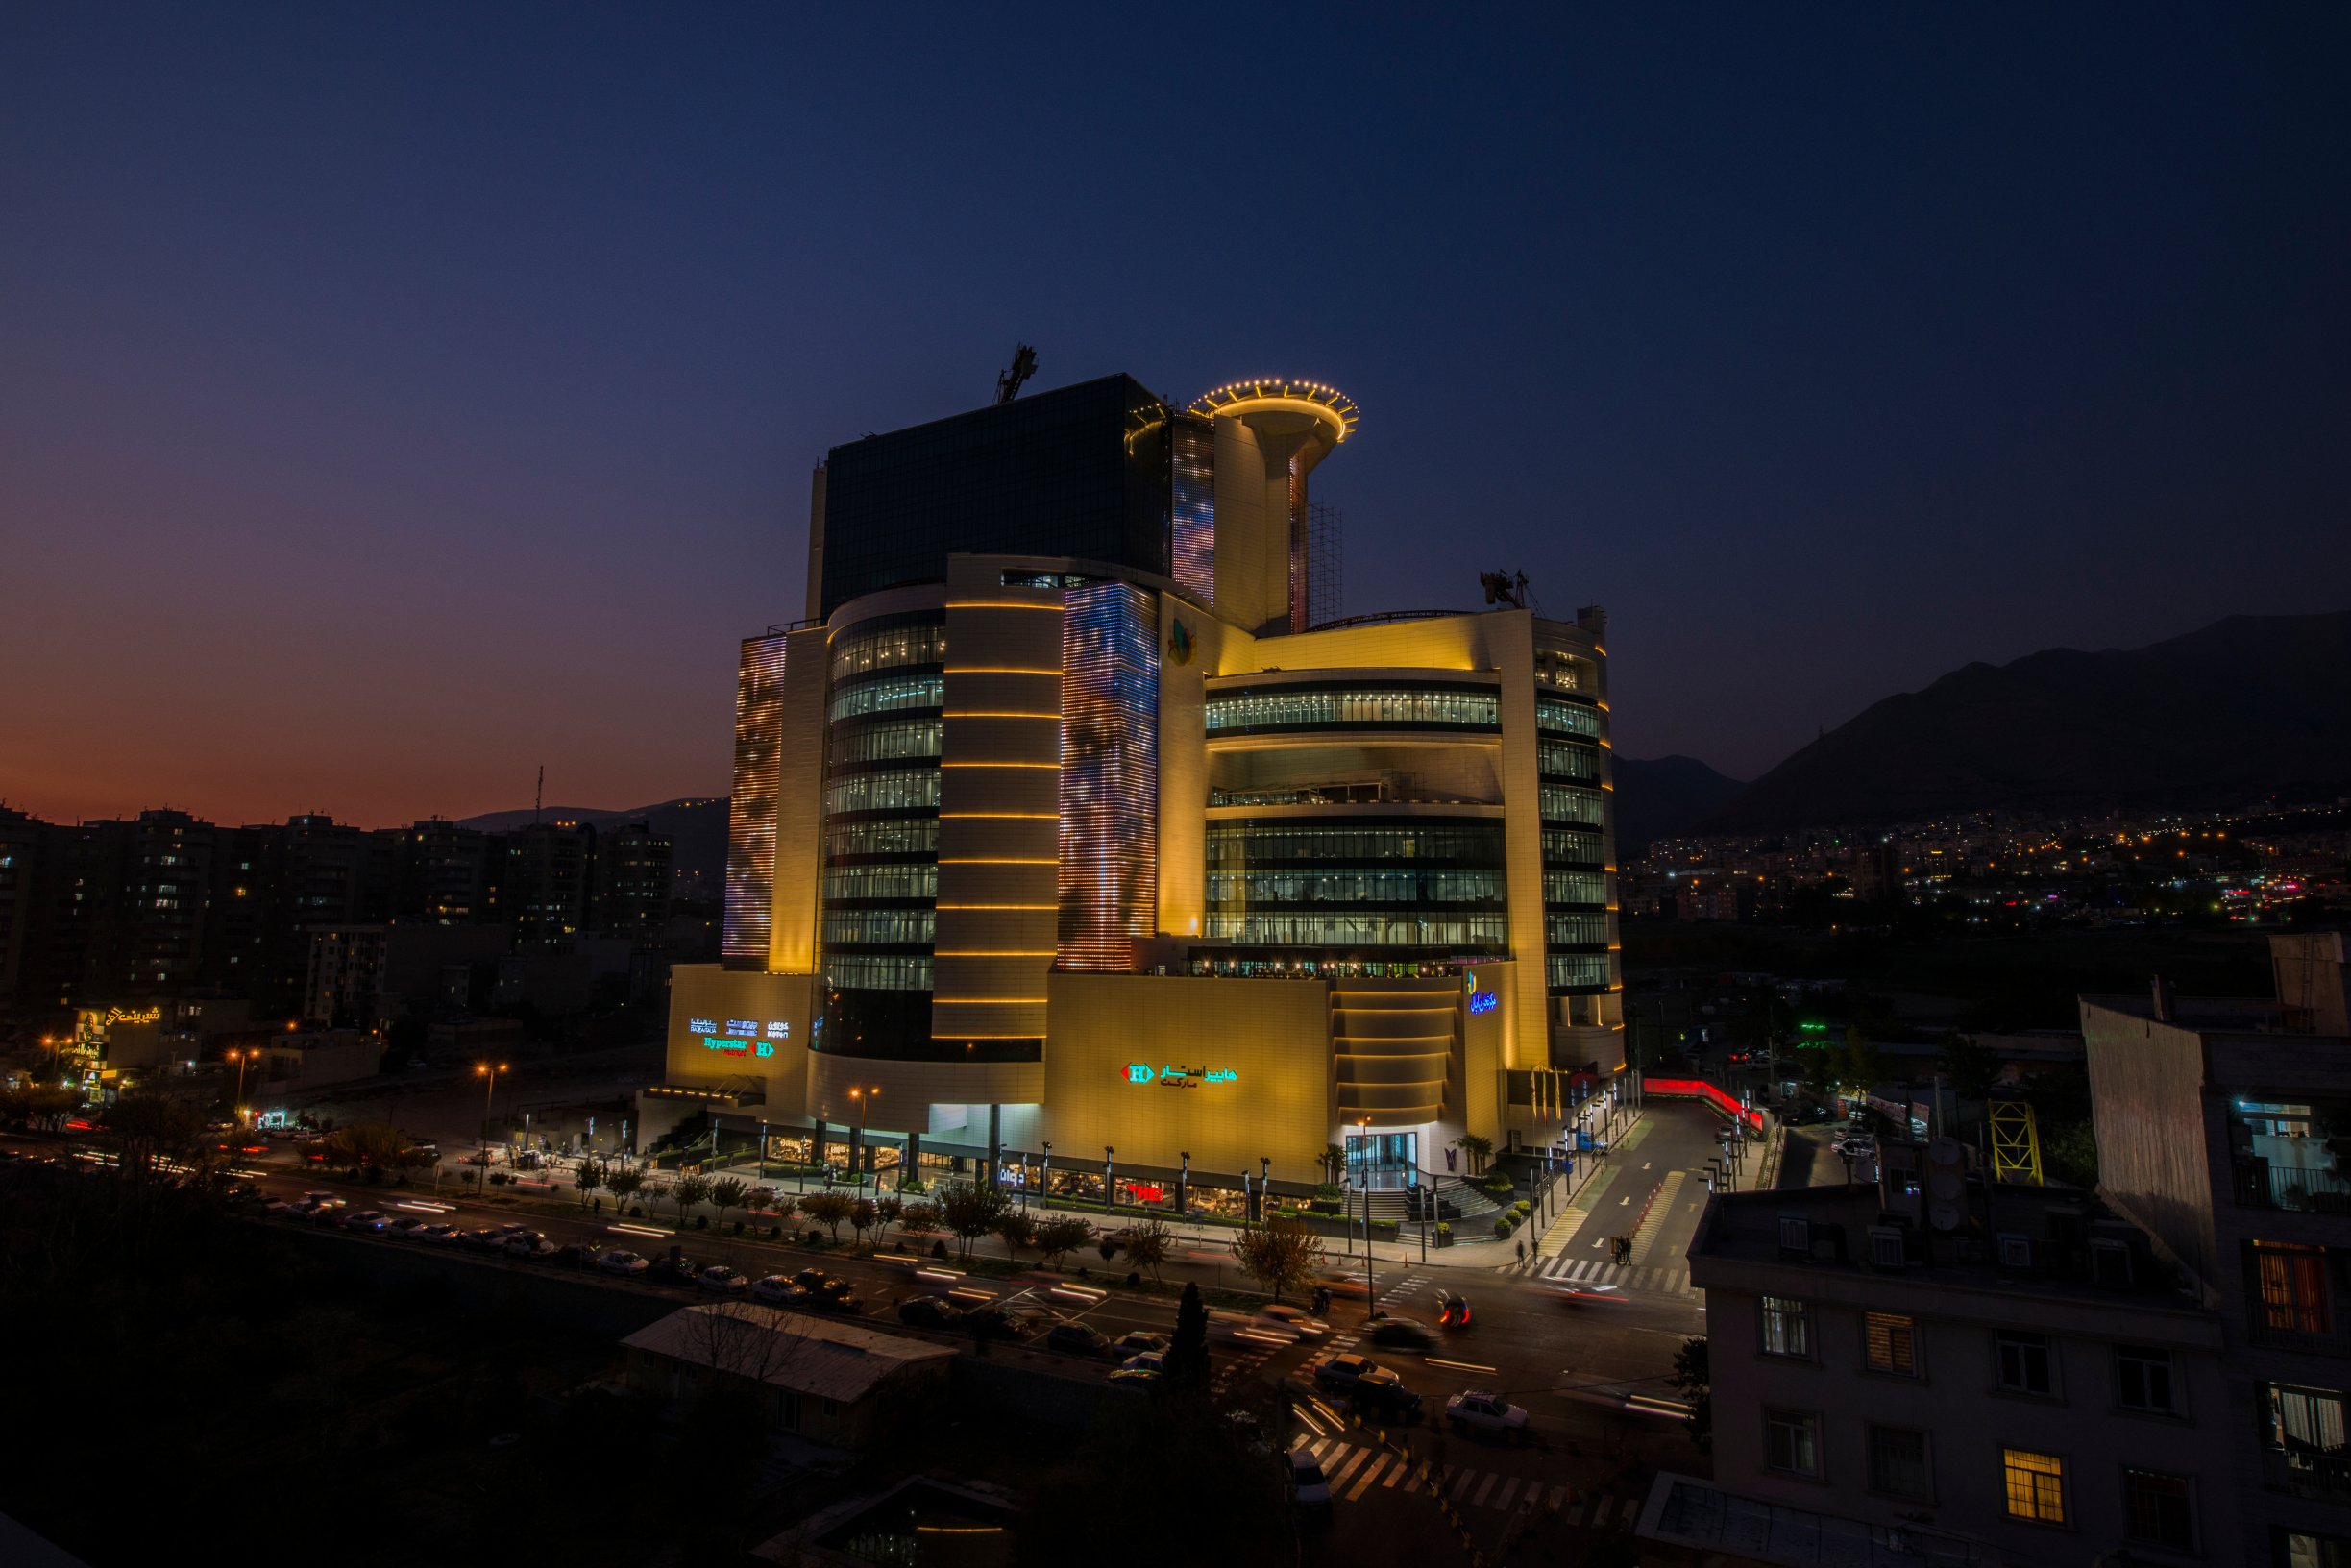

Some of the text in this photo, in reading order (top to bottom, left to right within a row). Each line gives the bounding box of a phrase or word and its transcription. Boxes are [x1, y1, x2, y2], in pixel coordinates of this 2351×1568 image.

[118, 1007, 160, 1024] شیرینی
[703, 1037, 747, 1050] Hyperstar
[1160, 1077, 1198, 1089] مارکت
